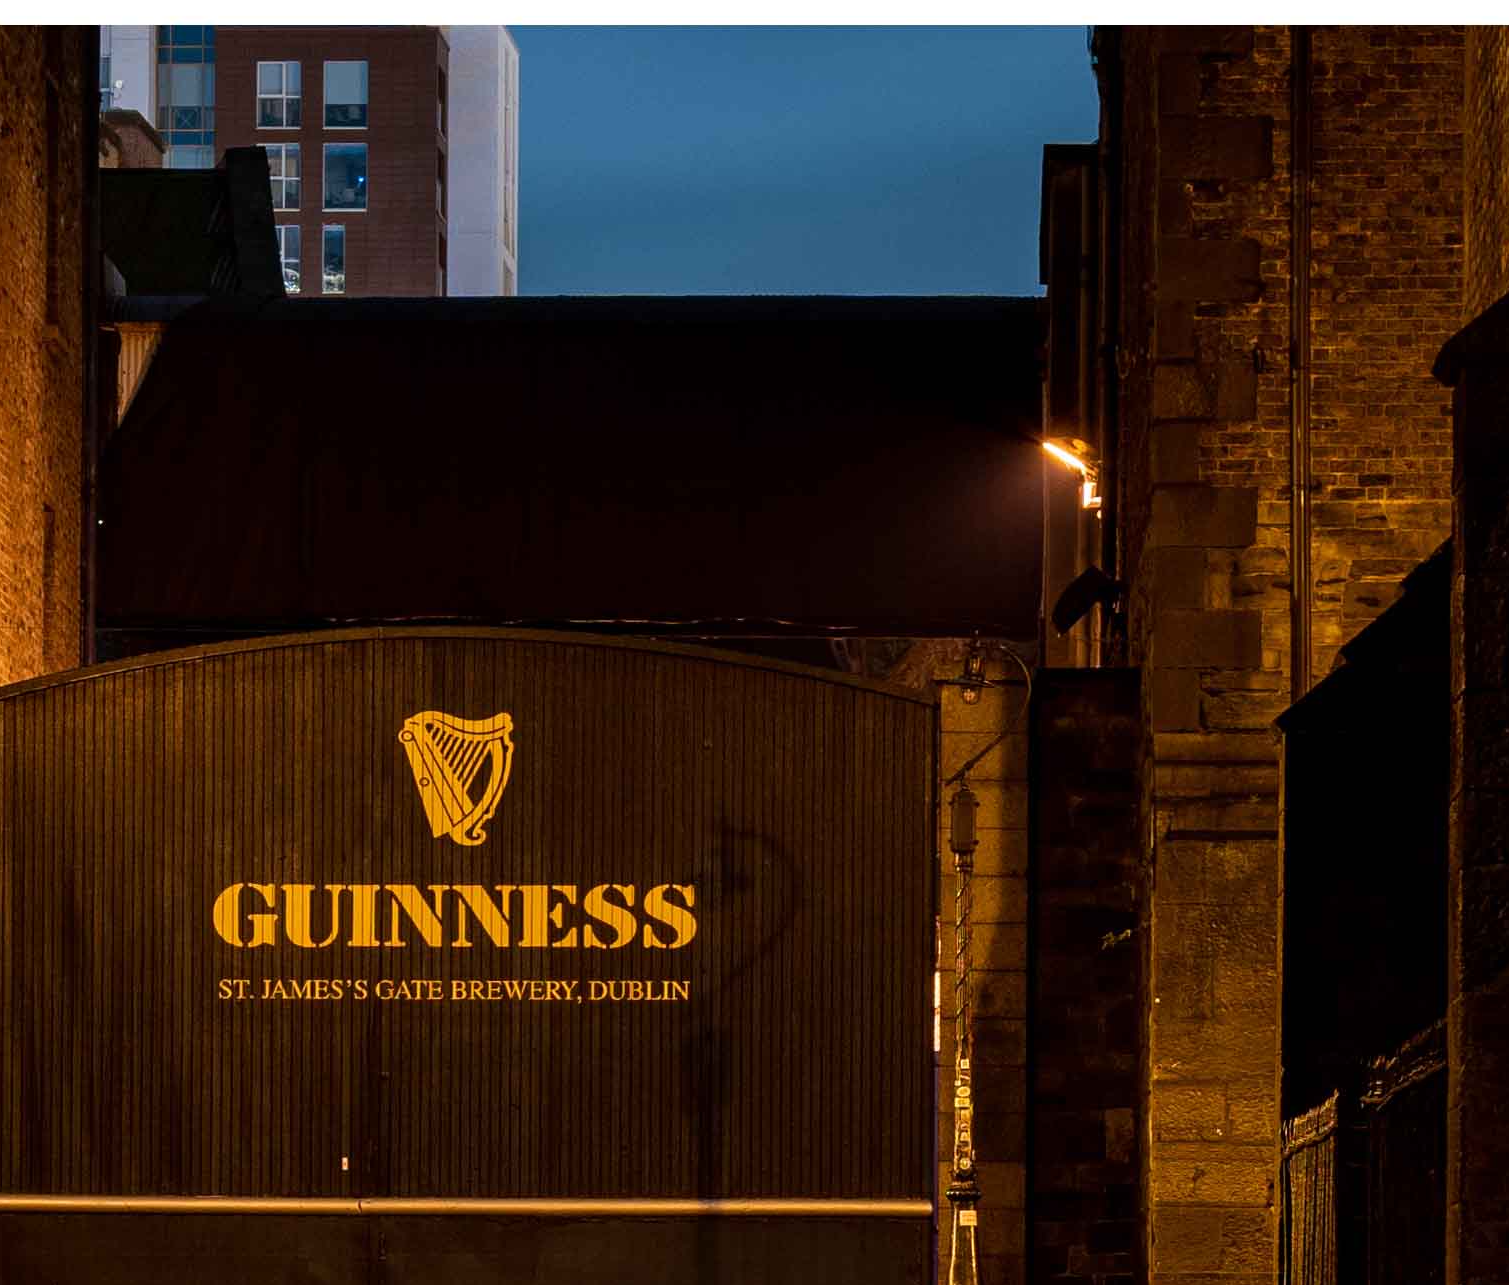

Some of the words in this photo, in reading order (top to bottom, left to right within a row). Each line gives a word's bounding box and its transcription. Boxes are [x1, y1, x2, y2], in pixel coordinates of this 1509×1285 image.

[212, 882, 698, 949] GUINNESS
[218, 978, 255, 1000] ST.
[261, 978, 368, 1000] JAMES’S
[375, 979, 444, 1000] GATE
[450, 979, 583, 1004] BREWERY,
[588, 980, 691, 1001] DUBLIN
